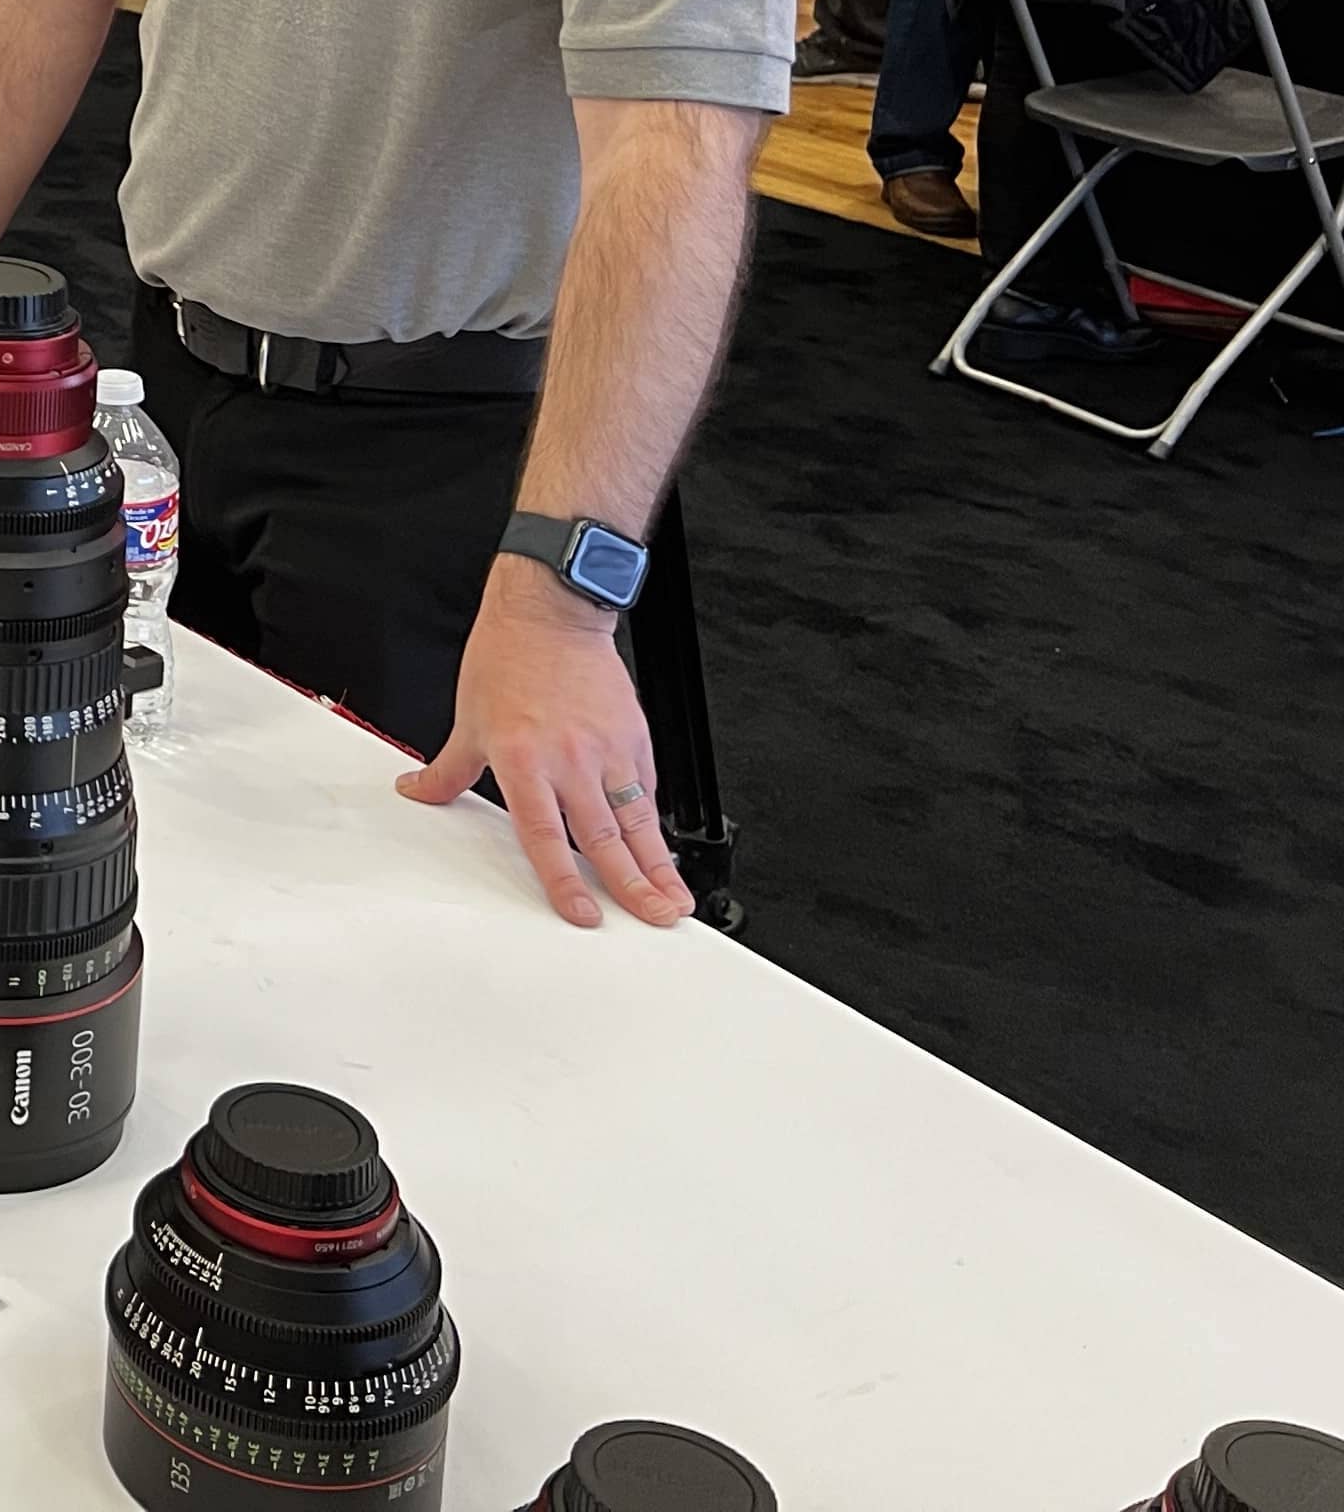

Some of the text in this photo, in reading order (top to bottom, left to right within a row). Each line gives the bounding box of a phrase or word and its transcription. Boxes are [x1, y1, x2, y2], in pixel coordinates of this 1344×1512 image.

[24, 716, 37, 738] 200
[10, 1049, 33, 1126] Canon
[67, 1030, 95, 1125] 30-300
[183, 1256, 191, 1265] 8
[189, 1264, 200, 1277] 11
[199, 1269, 211, 1283] 16
[209, 1275, 222, 1291] 22
[139, 1323, 149, 1339] 60
[149, 1333, 160, 1349] 40
[160, 1342, 173, 1360] 30
[171, 1350, 183, 1368] 25
[189, 1361, 201, 1379] 20
[225, 1377, 237, 1392] 15
[264, 1389, 276, 1404] 12
[305, 1395, 317, 1411] 10
[332, 1396, 344, 1406] 9
[365, 1394, 376, 1404] 8
[402, 1384, 411, 1392] 7
[170, 1457, 191, 1494] 135
